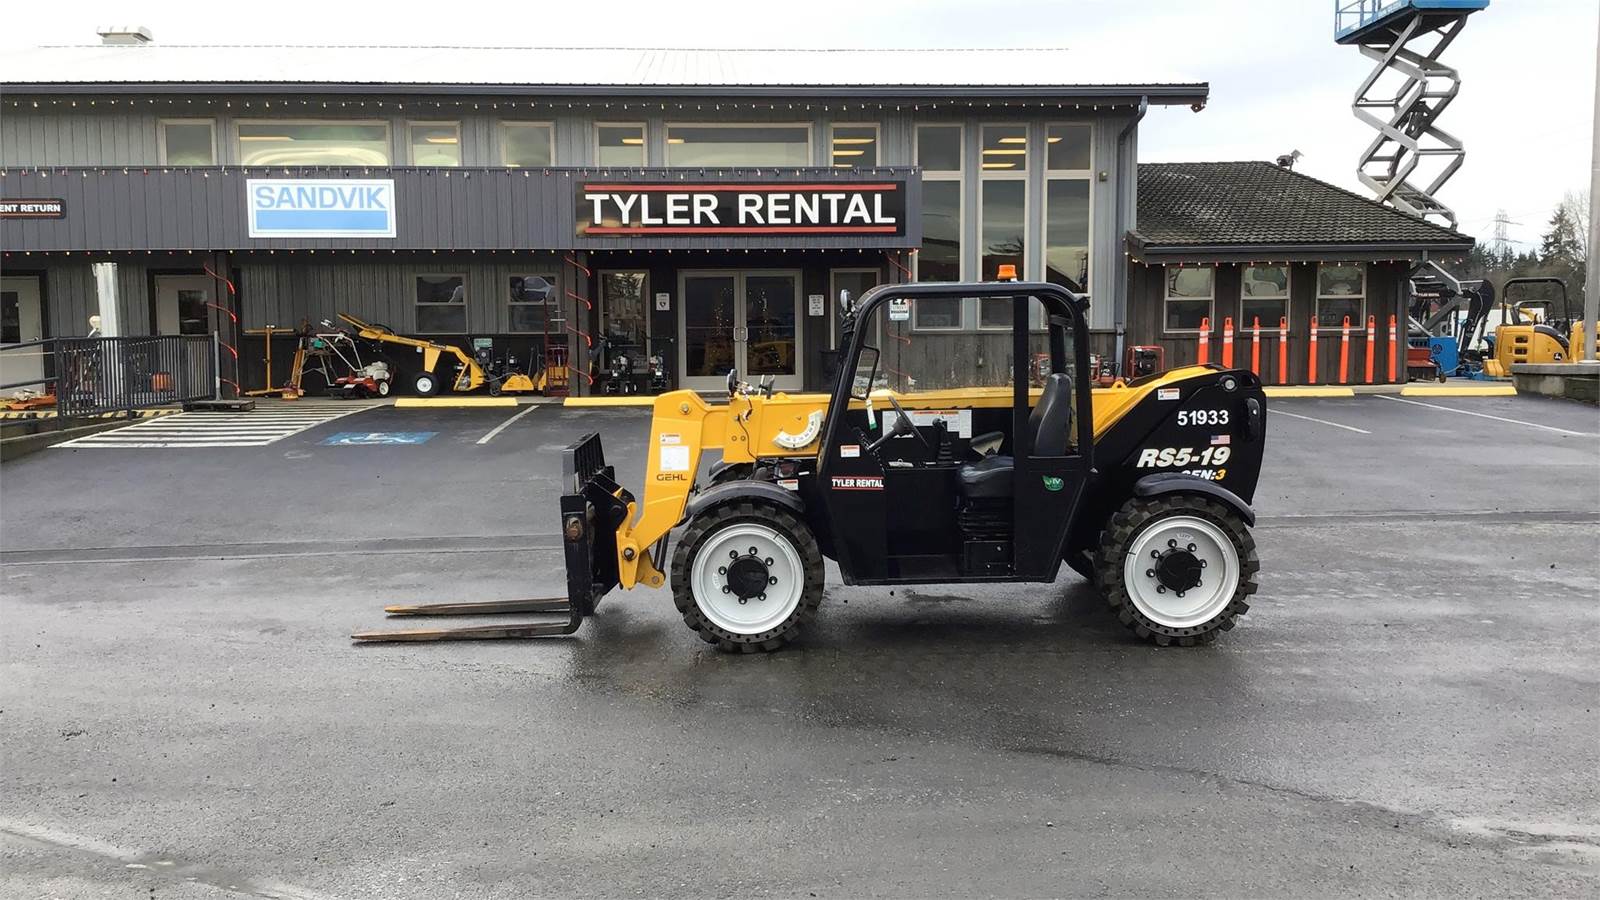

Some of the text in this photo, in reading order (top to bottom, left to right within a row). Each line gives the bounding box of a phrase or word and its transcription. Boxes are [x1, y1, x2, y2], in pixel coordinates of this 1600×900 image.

[255, 186, 386, 209] SANDVIK
[20, 204, 61, 212] RETURN
[585, 193, 896, 225] TYLER RENTAL
[1177, 410, 1229, 426] 51933
[1136, 446, 1231, 468] RS5-19
[656, 473, 688, 481] GEHL
[832, 478, 884, 488] TYLER RENTAL
